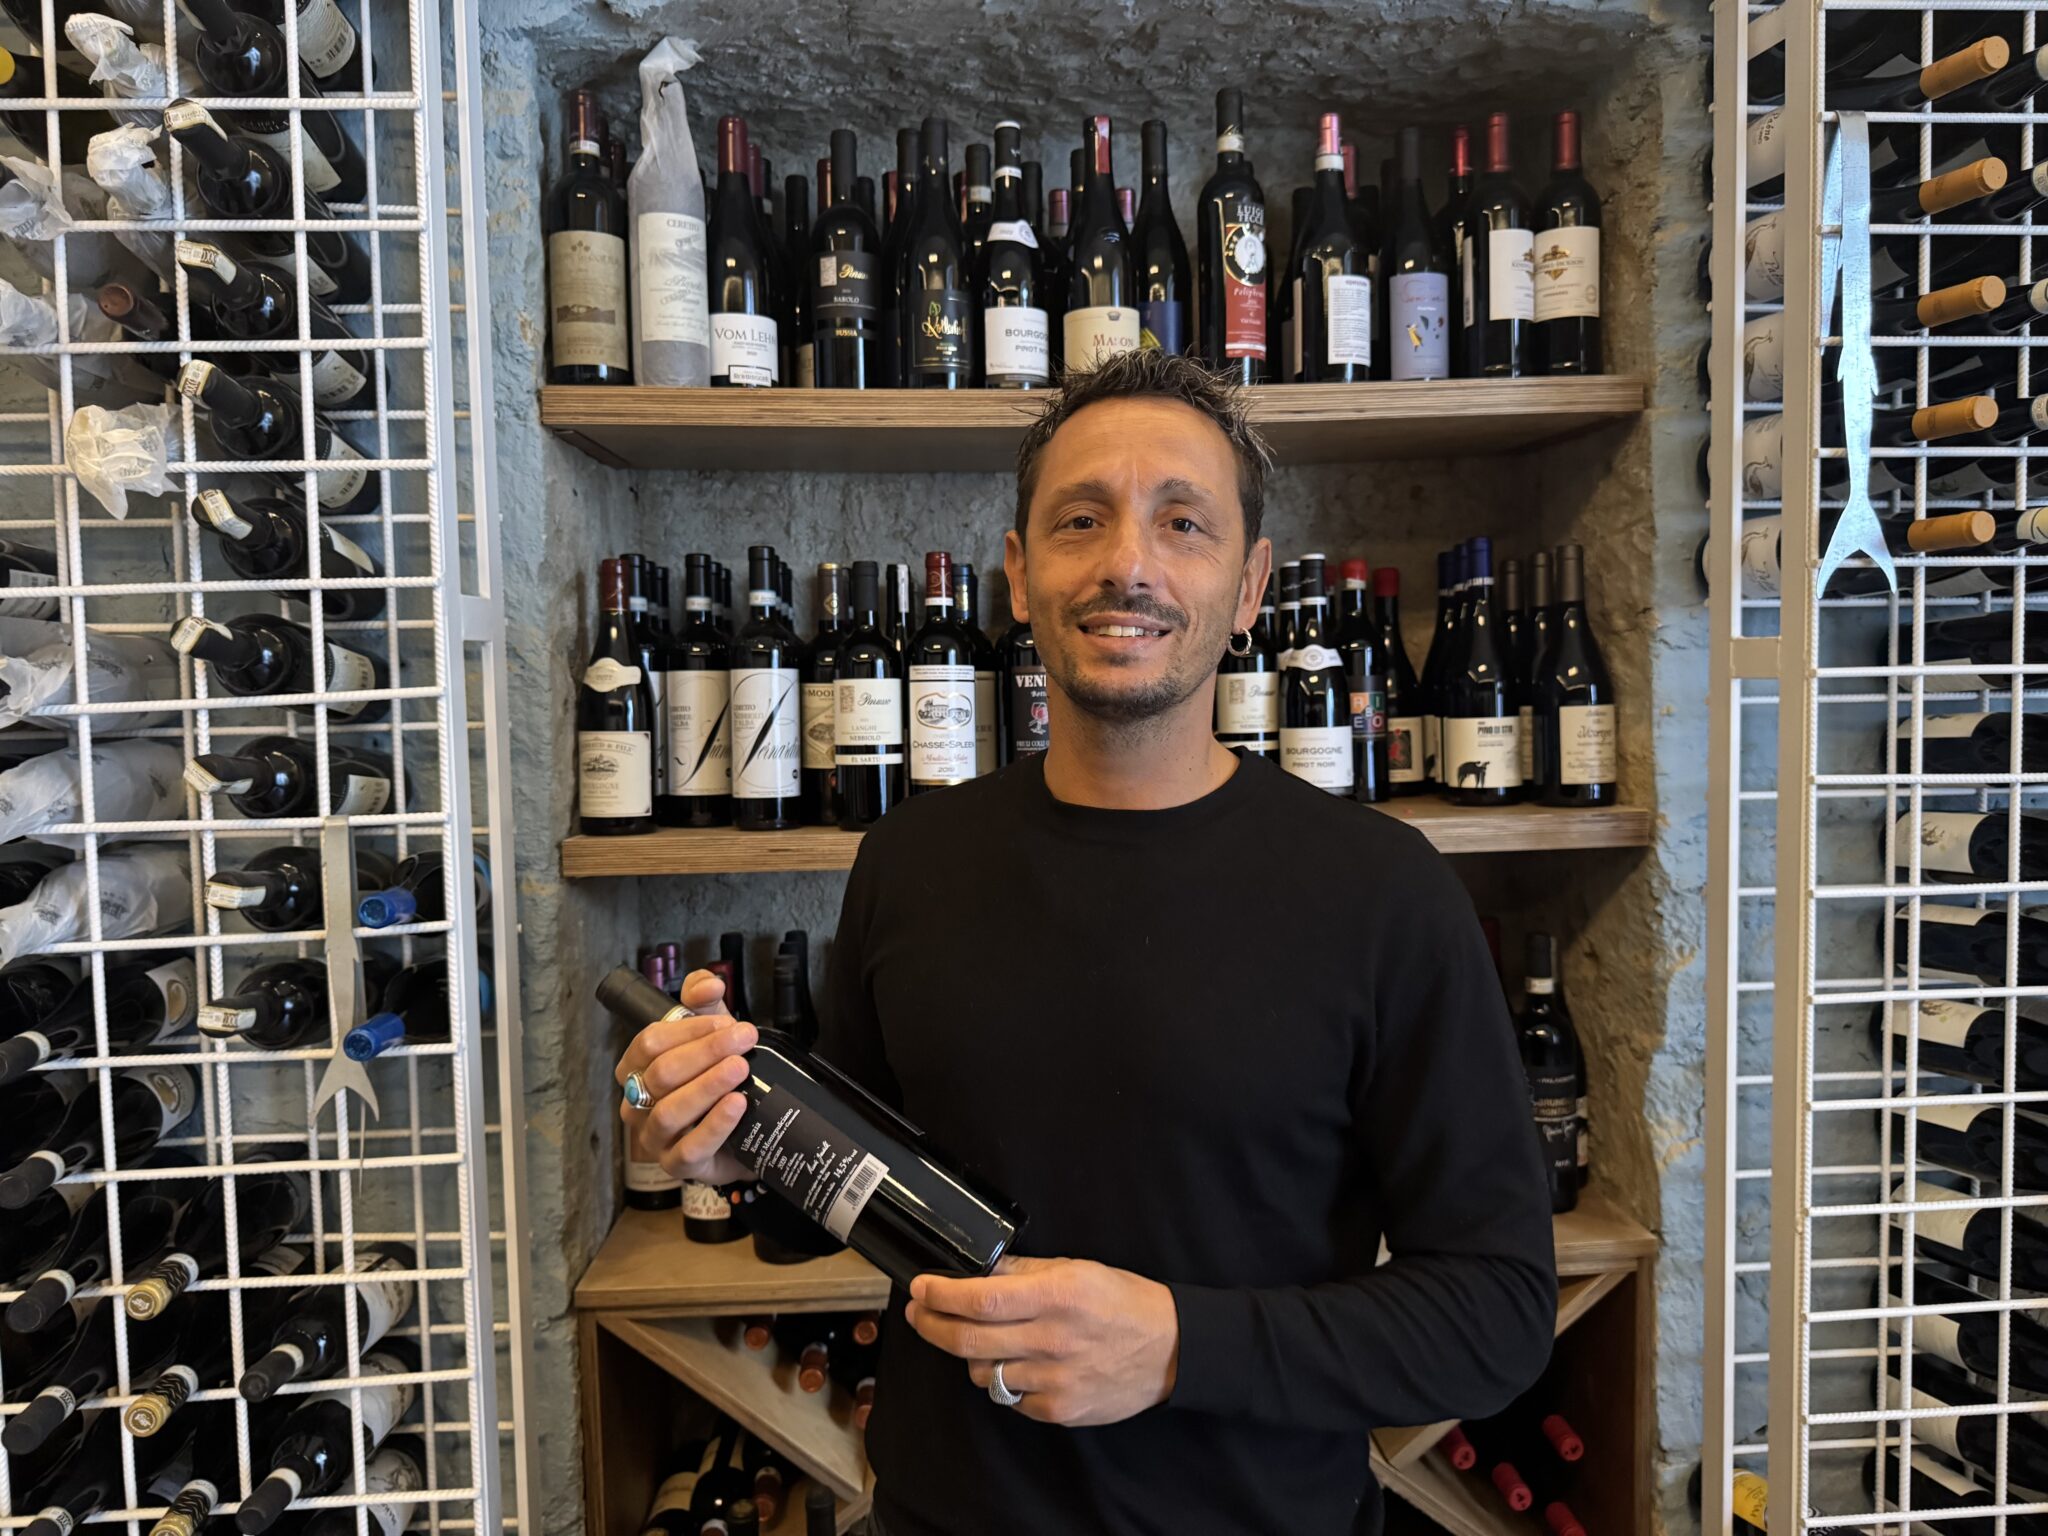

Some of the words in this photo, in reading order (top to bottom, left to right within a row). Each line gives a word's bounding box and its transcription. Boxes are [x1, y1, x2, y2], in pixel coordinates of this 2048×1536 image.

[714, 327, 747, 341] VOM
[1285, 747, 1343, 755] BOURGOGNE
[762, 1108, 794, 1151] Montepulciano
